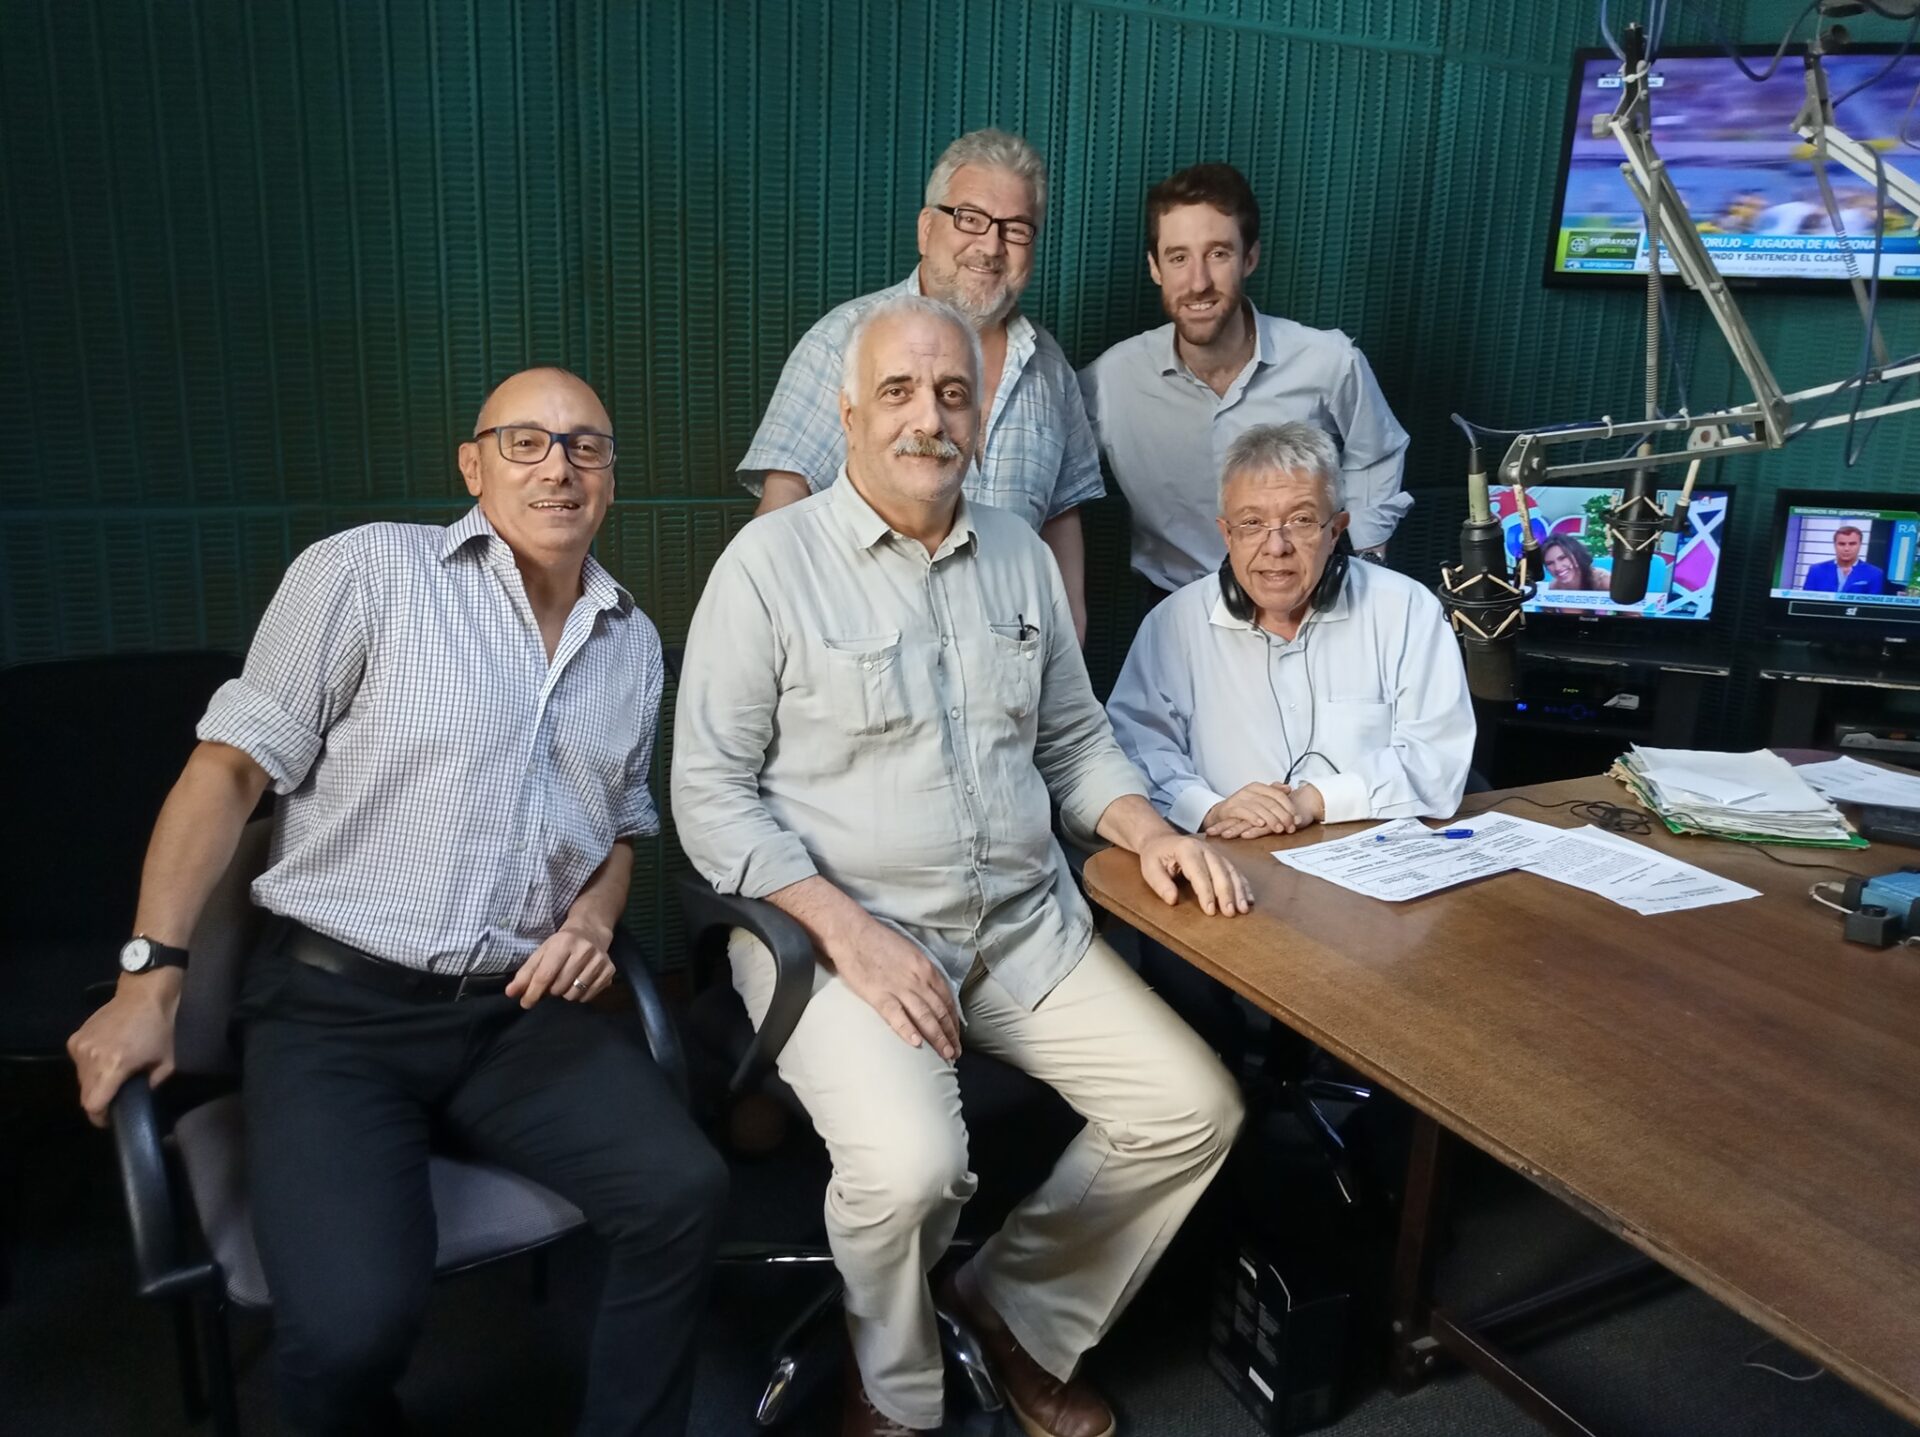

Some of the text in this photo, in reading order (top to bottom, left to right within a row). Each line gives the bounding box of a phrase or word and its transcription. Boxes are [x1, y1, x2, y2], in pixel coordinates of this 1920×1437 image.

[1589, 237, 1638, 246] SUBRAYADO
[1750, 238, 1804, 250] JUGADOR
[1806, 239, 1821, 250] DE
[1744, 253, 1798, 262] SENTENCIO
[1799, 254, 1811, 262] EL
